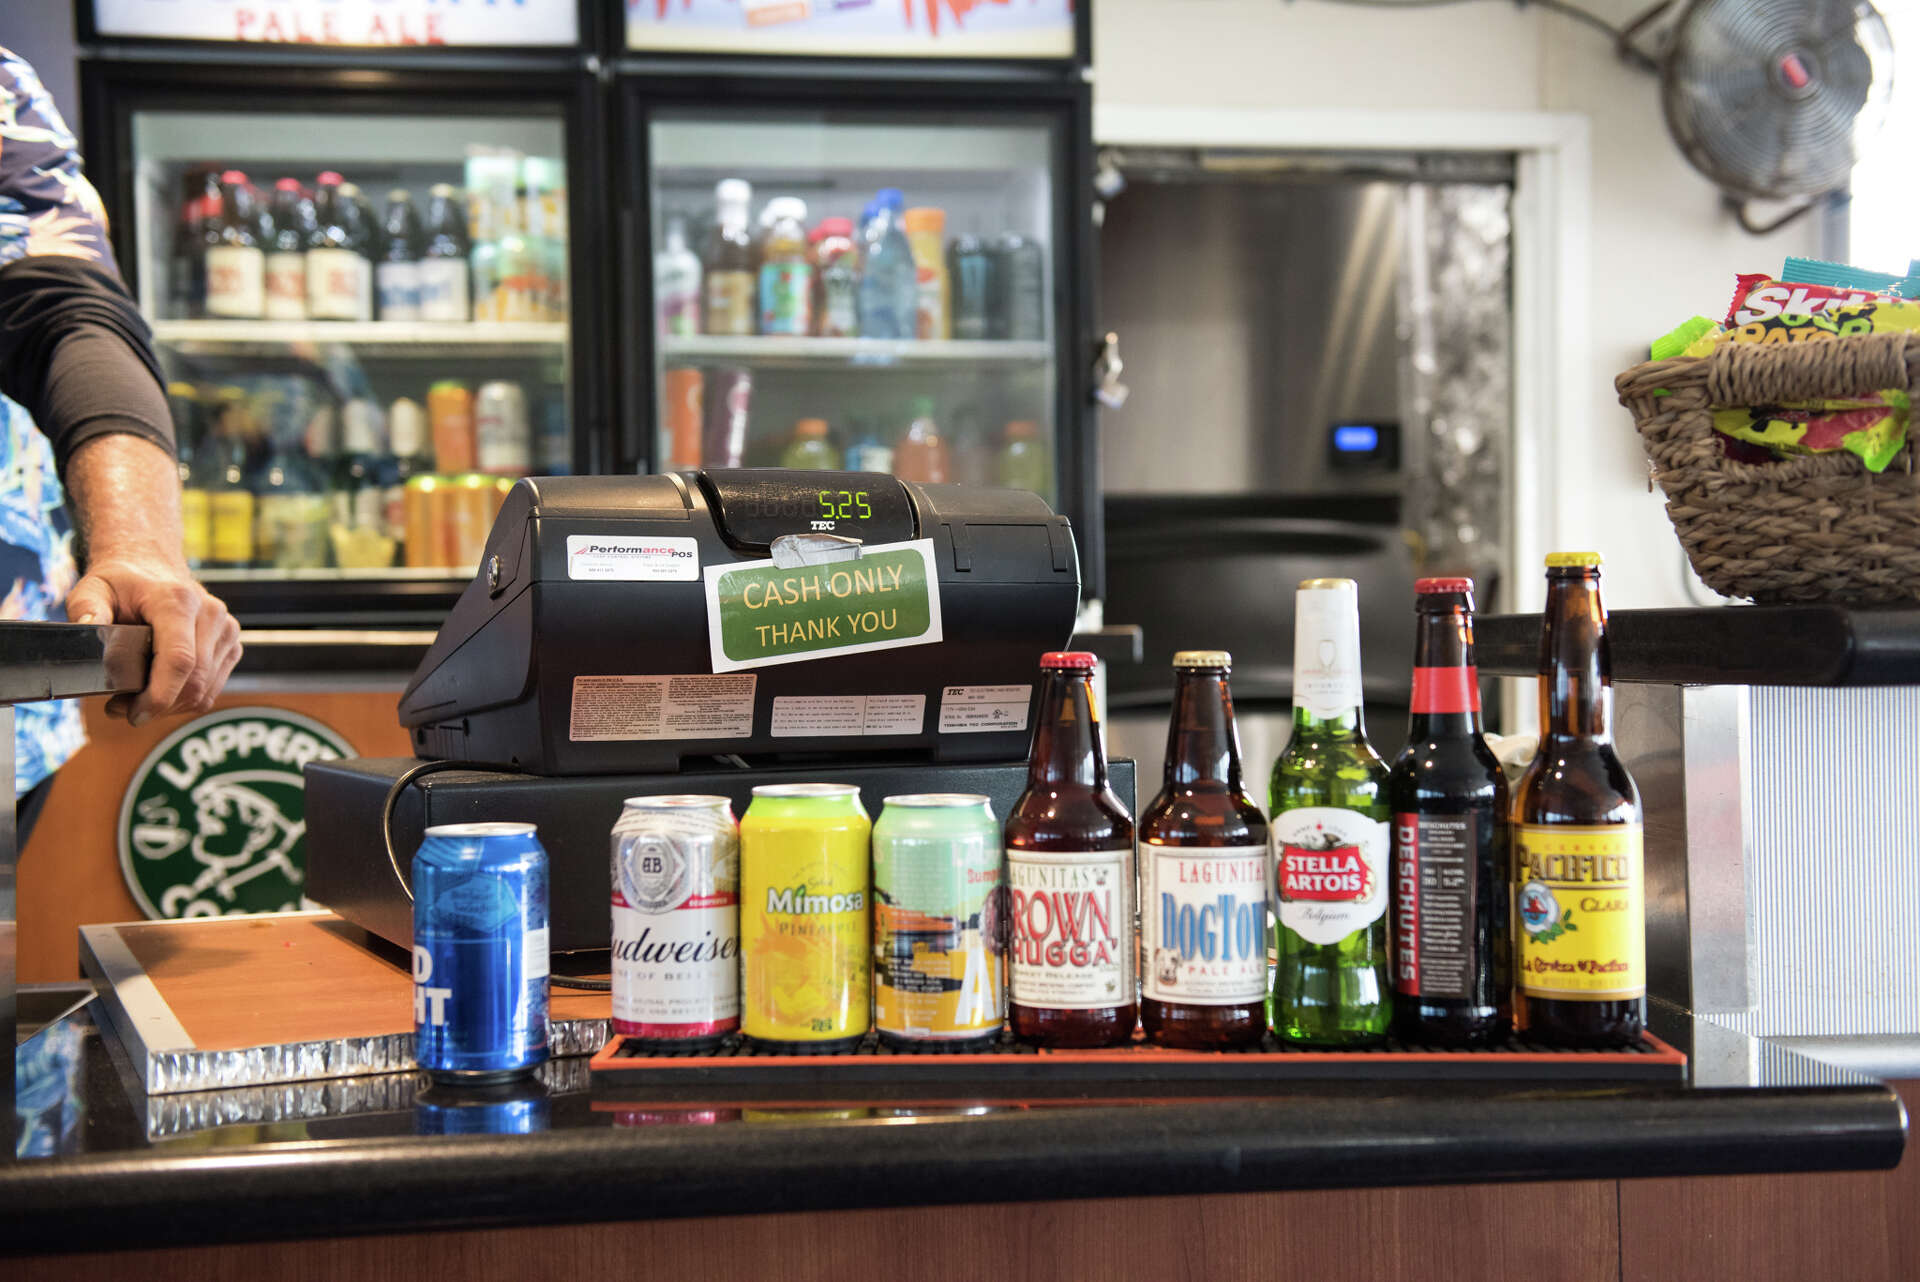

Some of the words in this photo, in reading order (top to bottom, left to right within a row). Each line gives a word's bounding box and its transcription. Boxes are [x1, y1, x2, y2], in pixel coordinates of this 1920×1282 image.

[234, 8, 340, 44] PALE
[370, 13, 445, 46] ALE
[818, 490, 872, 520] 5.25
[810, 520, 835, 532] TEC
[589, 545, 676, 555] Performance
[671, 551, 693, 559] POS
[743, 575, 821, 610] CASH
[830, 563, 904, 599] ONLY
[754, 616, 841, 648] THANK
[846, 608, 898, 636] YOU
[1286, 856, 1360, 873] STELLA
[1286, 875, 1361, 892] ARTOIS
[767, 885, 864, 914] Mimosa
[1400, 825, 1416, 981] DESCHUTES
